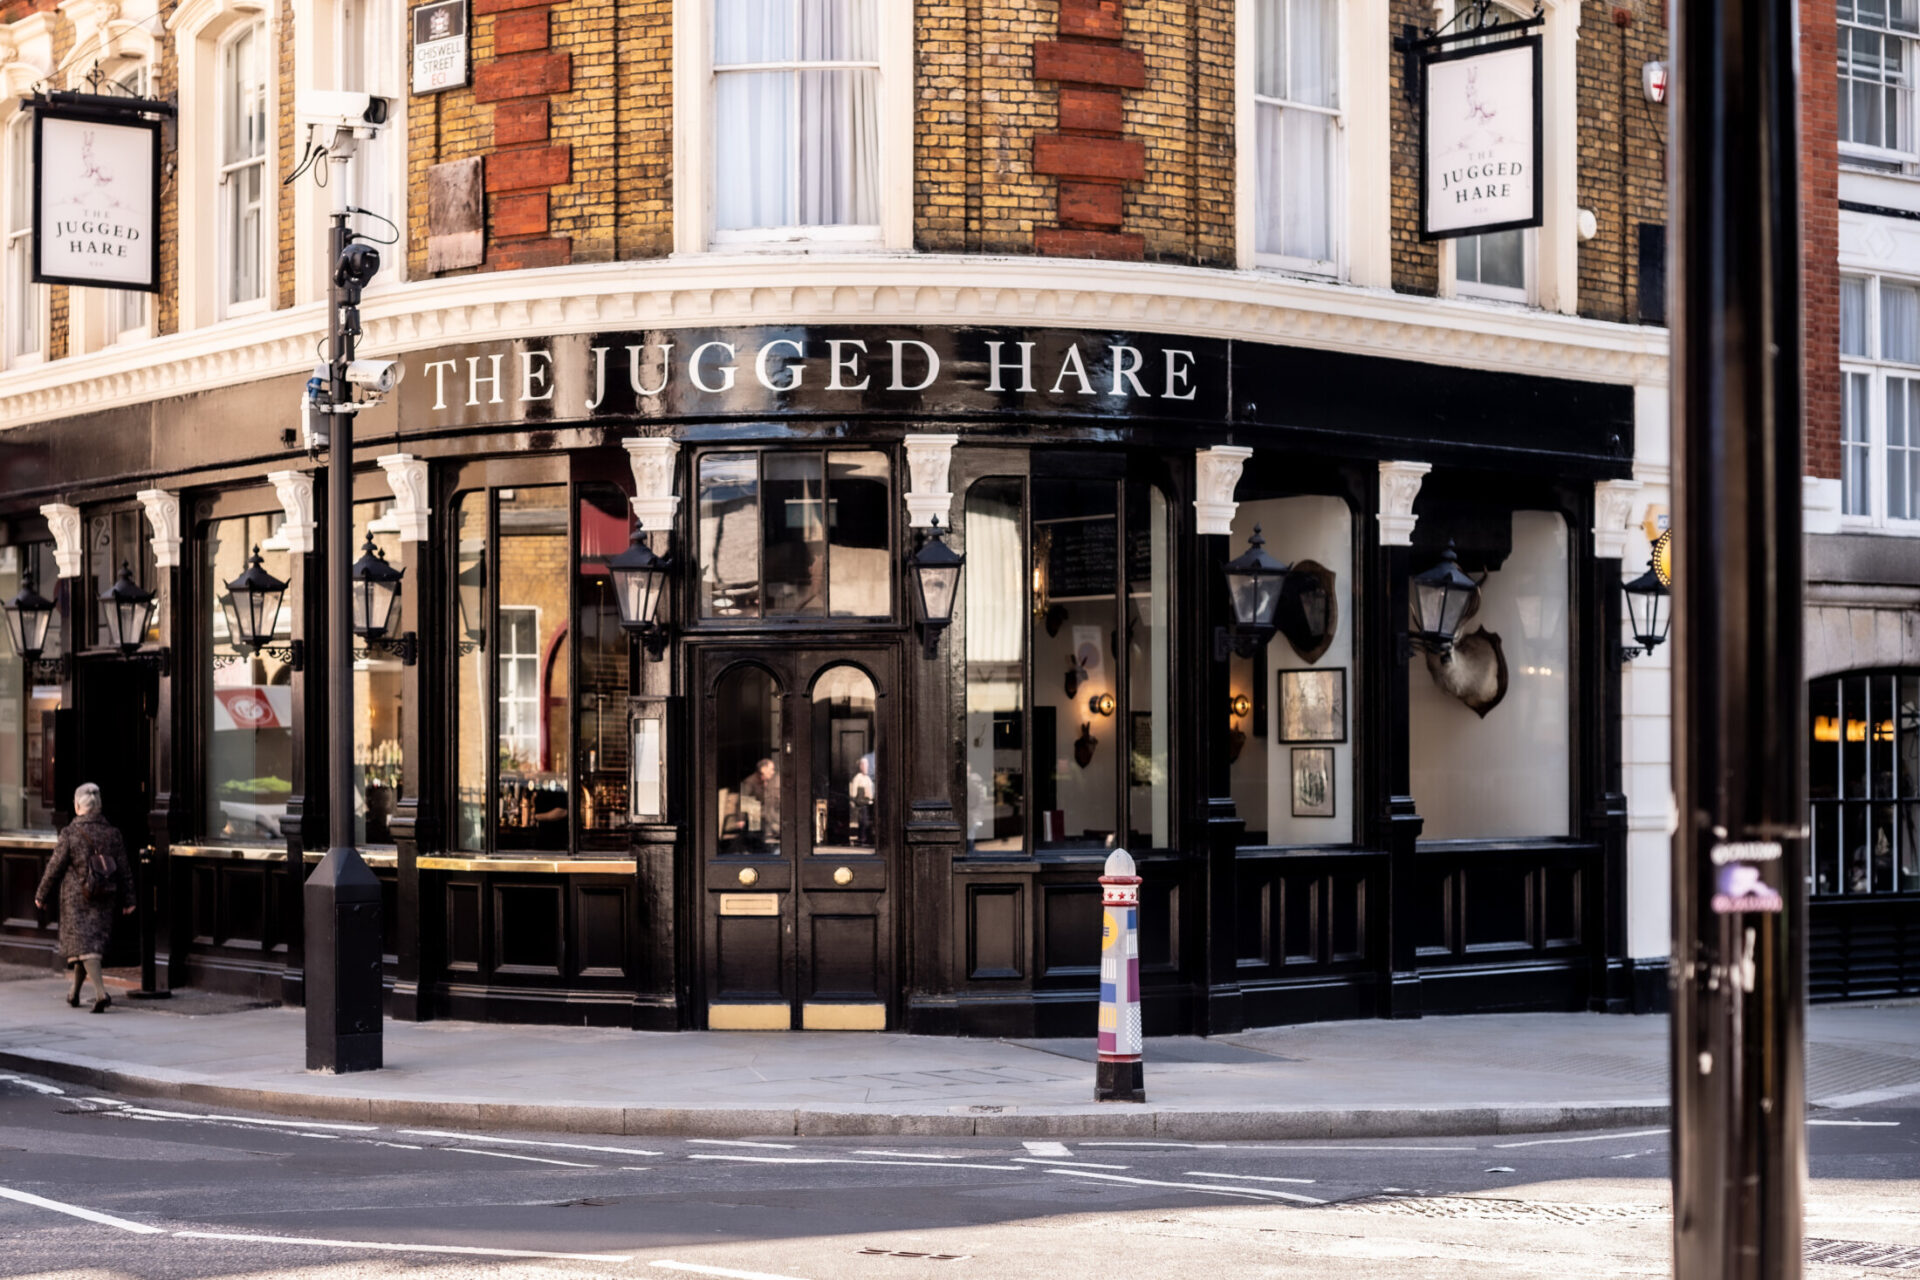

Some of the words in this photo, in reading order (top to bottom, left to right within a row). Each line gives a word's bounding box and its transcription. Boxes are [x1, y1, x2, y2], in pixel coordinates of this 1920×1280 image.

[417, 40, 462, 61] CHISWELL
[423, 56, 455, 74] STREET
[1467, 149, 1494, 161] THE
[1442, 162, 1523, 191] JUGGED
[1455, 183, 1511, 203] HARE
[83, 208, 110, 219] THE
[56, 221, 140, 241] JUGGED
[70, 240, 128, 258] HARE
[424, 350, 555, 411] THE
[585, 339, 941, 410] JUGGED
[984, 340, 1197, 400] HARE
